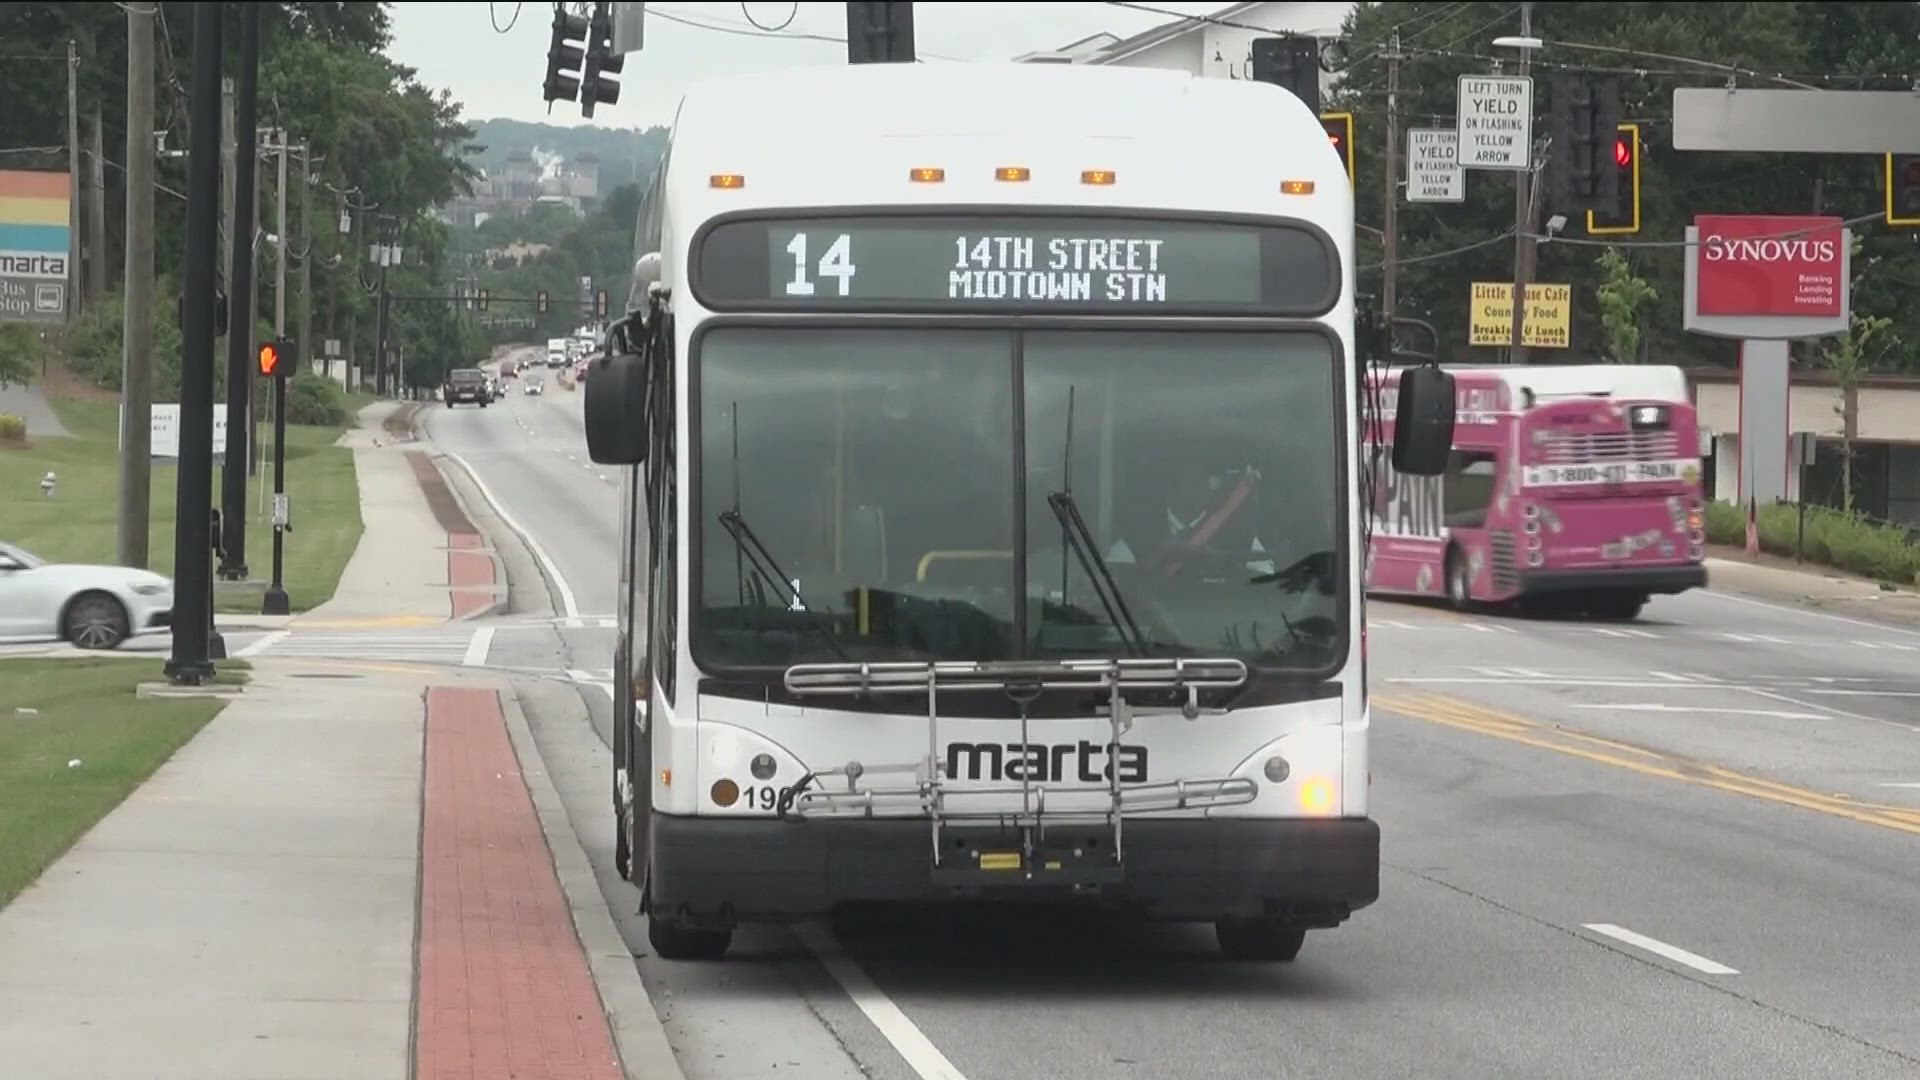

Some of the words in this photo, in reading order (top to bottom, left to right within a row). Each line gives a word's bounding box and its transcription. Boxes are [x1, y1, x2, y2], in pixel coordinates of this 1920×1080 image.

[1468, 82, 1491, 94] LEFT
[1497, 83, 1523, 95] TURN
[1473, 99, 1517, 114] YIELD
[1466, 118, 1477, 129] ON
[1481, 118, 1523, 131] FLASHING
[1415, 134, 1434, 143] LEFT
[1474, 135, 1513, 147] YELLOW
[1419, 147, 1454, 159] YIELD
[1475, 151, 1510, 162] ARROW
[1414, 161, 1422, 171] ON
[1421, 175, 1451, 185] YELLOW
[1422, 187, 1449, 196] ARROW
[956, 236, 1033, 269] 14TH
[1049, 238, 1163, 271] STREET
[1705, 235, 1834, 262] SYNOVUS
[786, 233, 856, 296] 14
[1799, 274, 1832, 285] Banking
[949, 271, 1091, 300] MIDTOWN
[1106, 272, 1166, 301] STN
[1799, 285, 1832, 295] Lending
[1475, 286, 1506, 299] Little
[1545, 288, 1568, 300] Cafe
[1794, 296, 1832, 305] Investing
[1533, 307, 1558, 318] Food
[1536, 326, 1565, 336] Lunch
[947, 740, 1148, 782] marta
